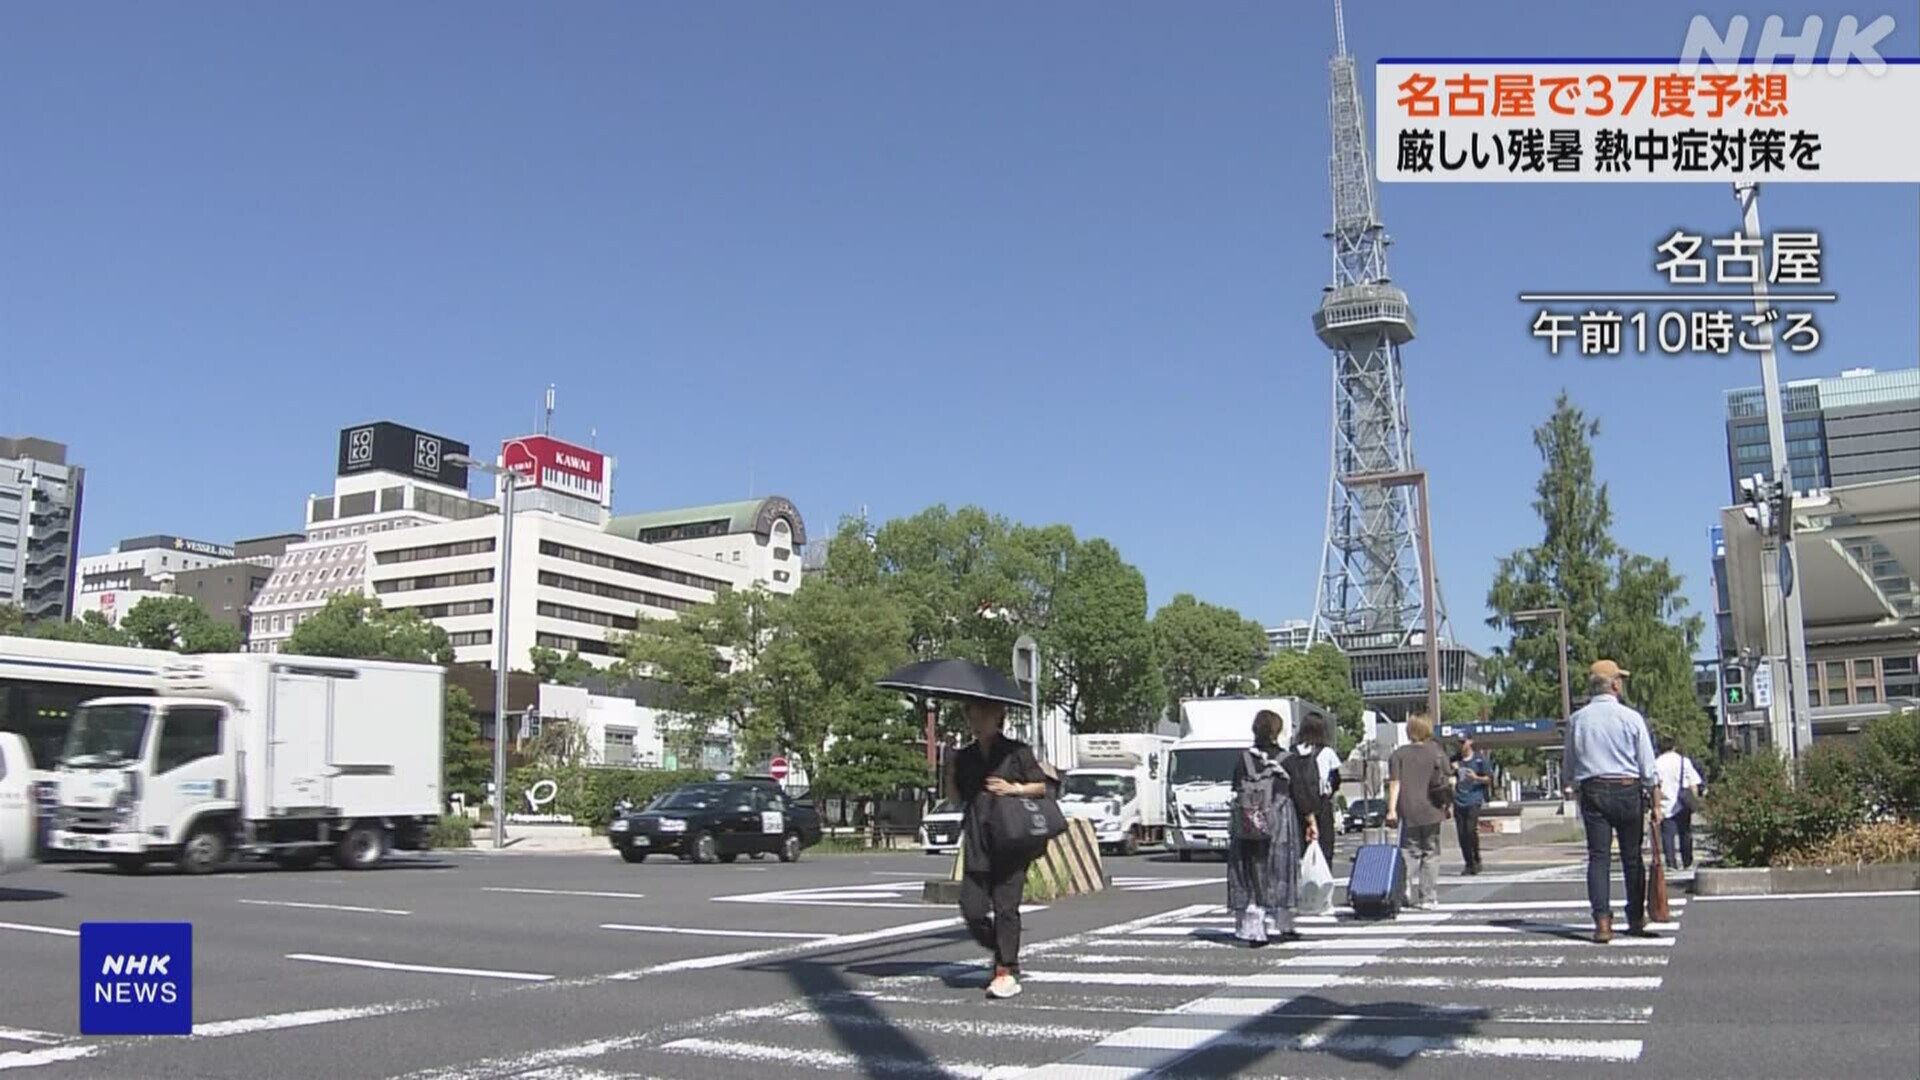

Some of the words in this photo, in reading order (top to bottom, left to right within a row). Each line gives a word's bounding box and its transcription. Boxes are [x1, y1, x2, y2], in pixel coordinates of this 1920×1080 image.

[353, 431, 370, 446] KO
[351, 445, 369, 460] KO
[419, 439, 437, 455] KO
[418, 453, 436, 469] KO
[555, 451, 591, 473] KAWAI
[185, 540, 217, 554] VESSEL
